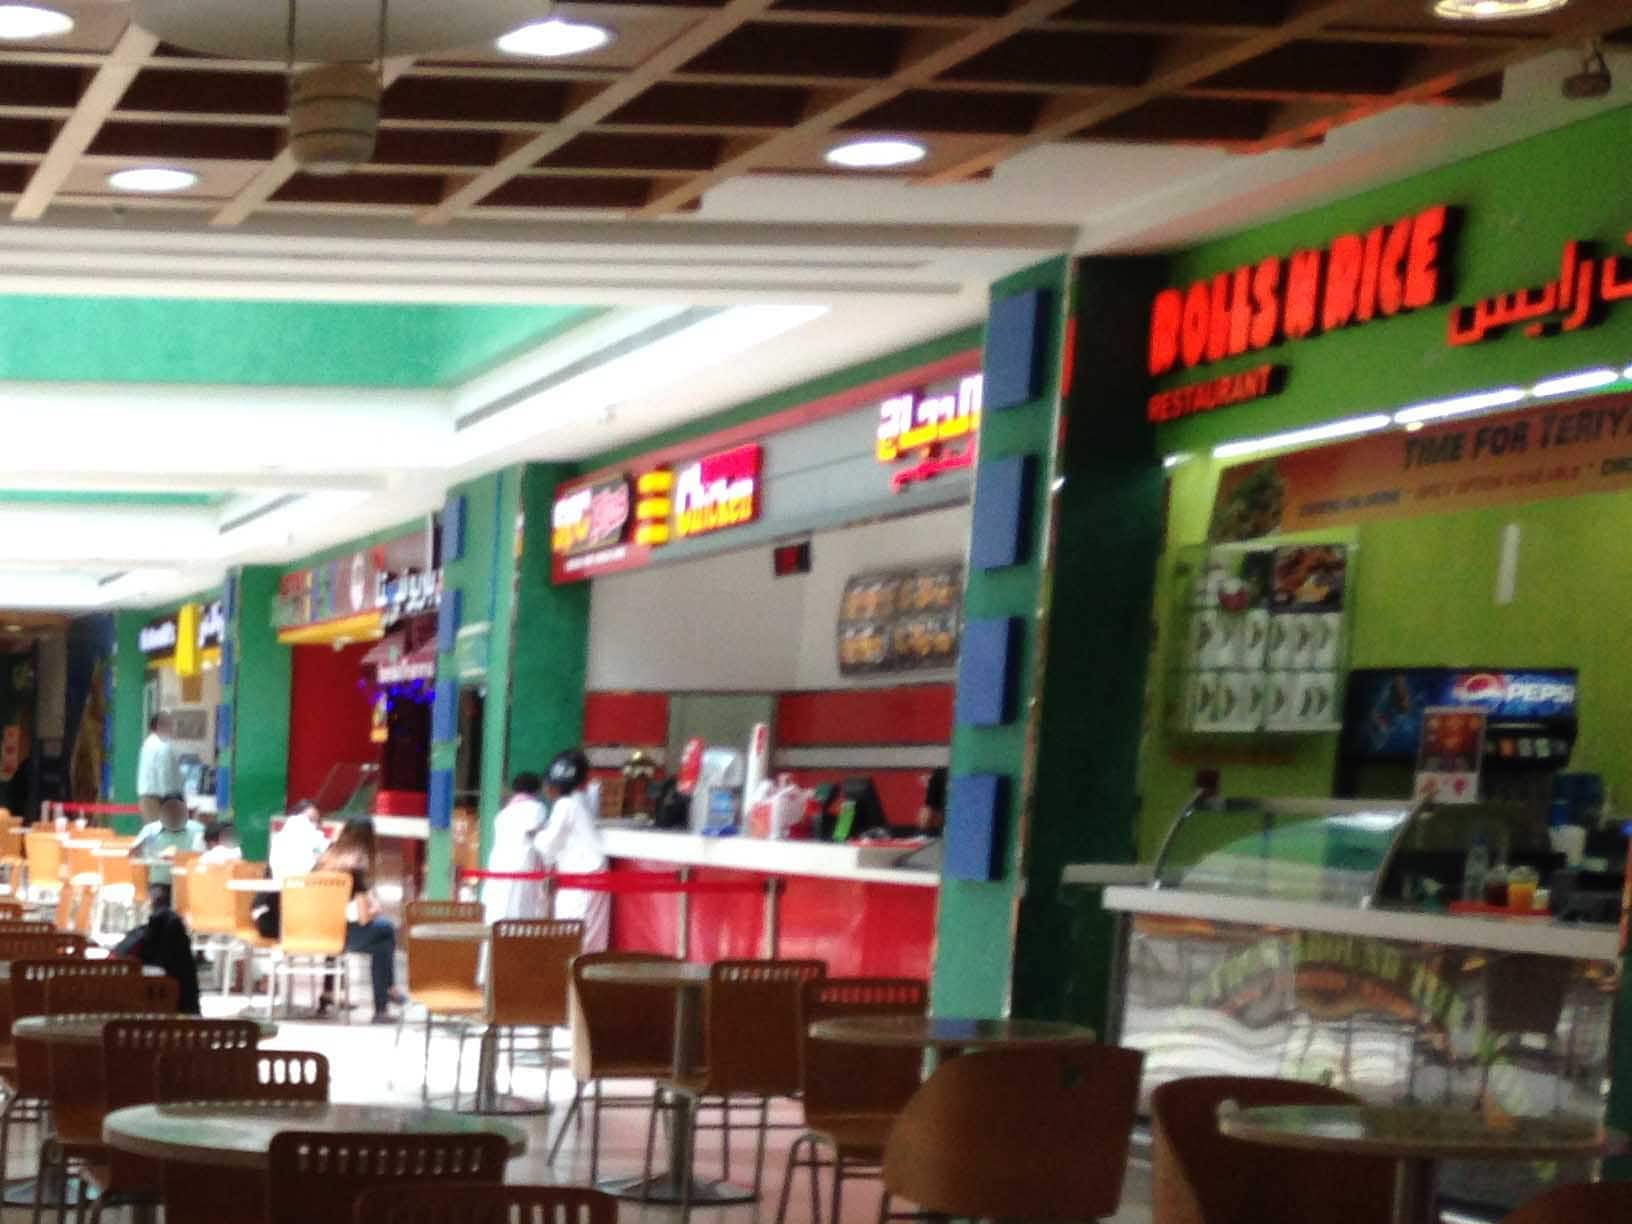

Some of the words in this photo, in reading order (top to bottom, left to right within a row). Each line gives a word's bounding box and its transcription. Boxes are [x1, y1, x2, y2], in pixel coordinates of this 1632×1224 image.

[1149, 256, 1280, 376] ROLLS
[1323, 204, 1448, 332] RICE
[1405, 430, 1464, 469] TIME
[1474, 420, 1529, 459] FOR
